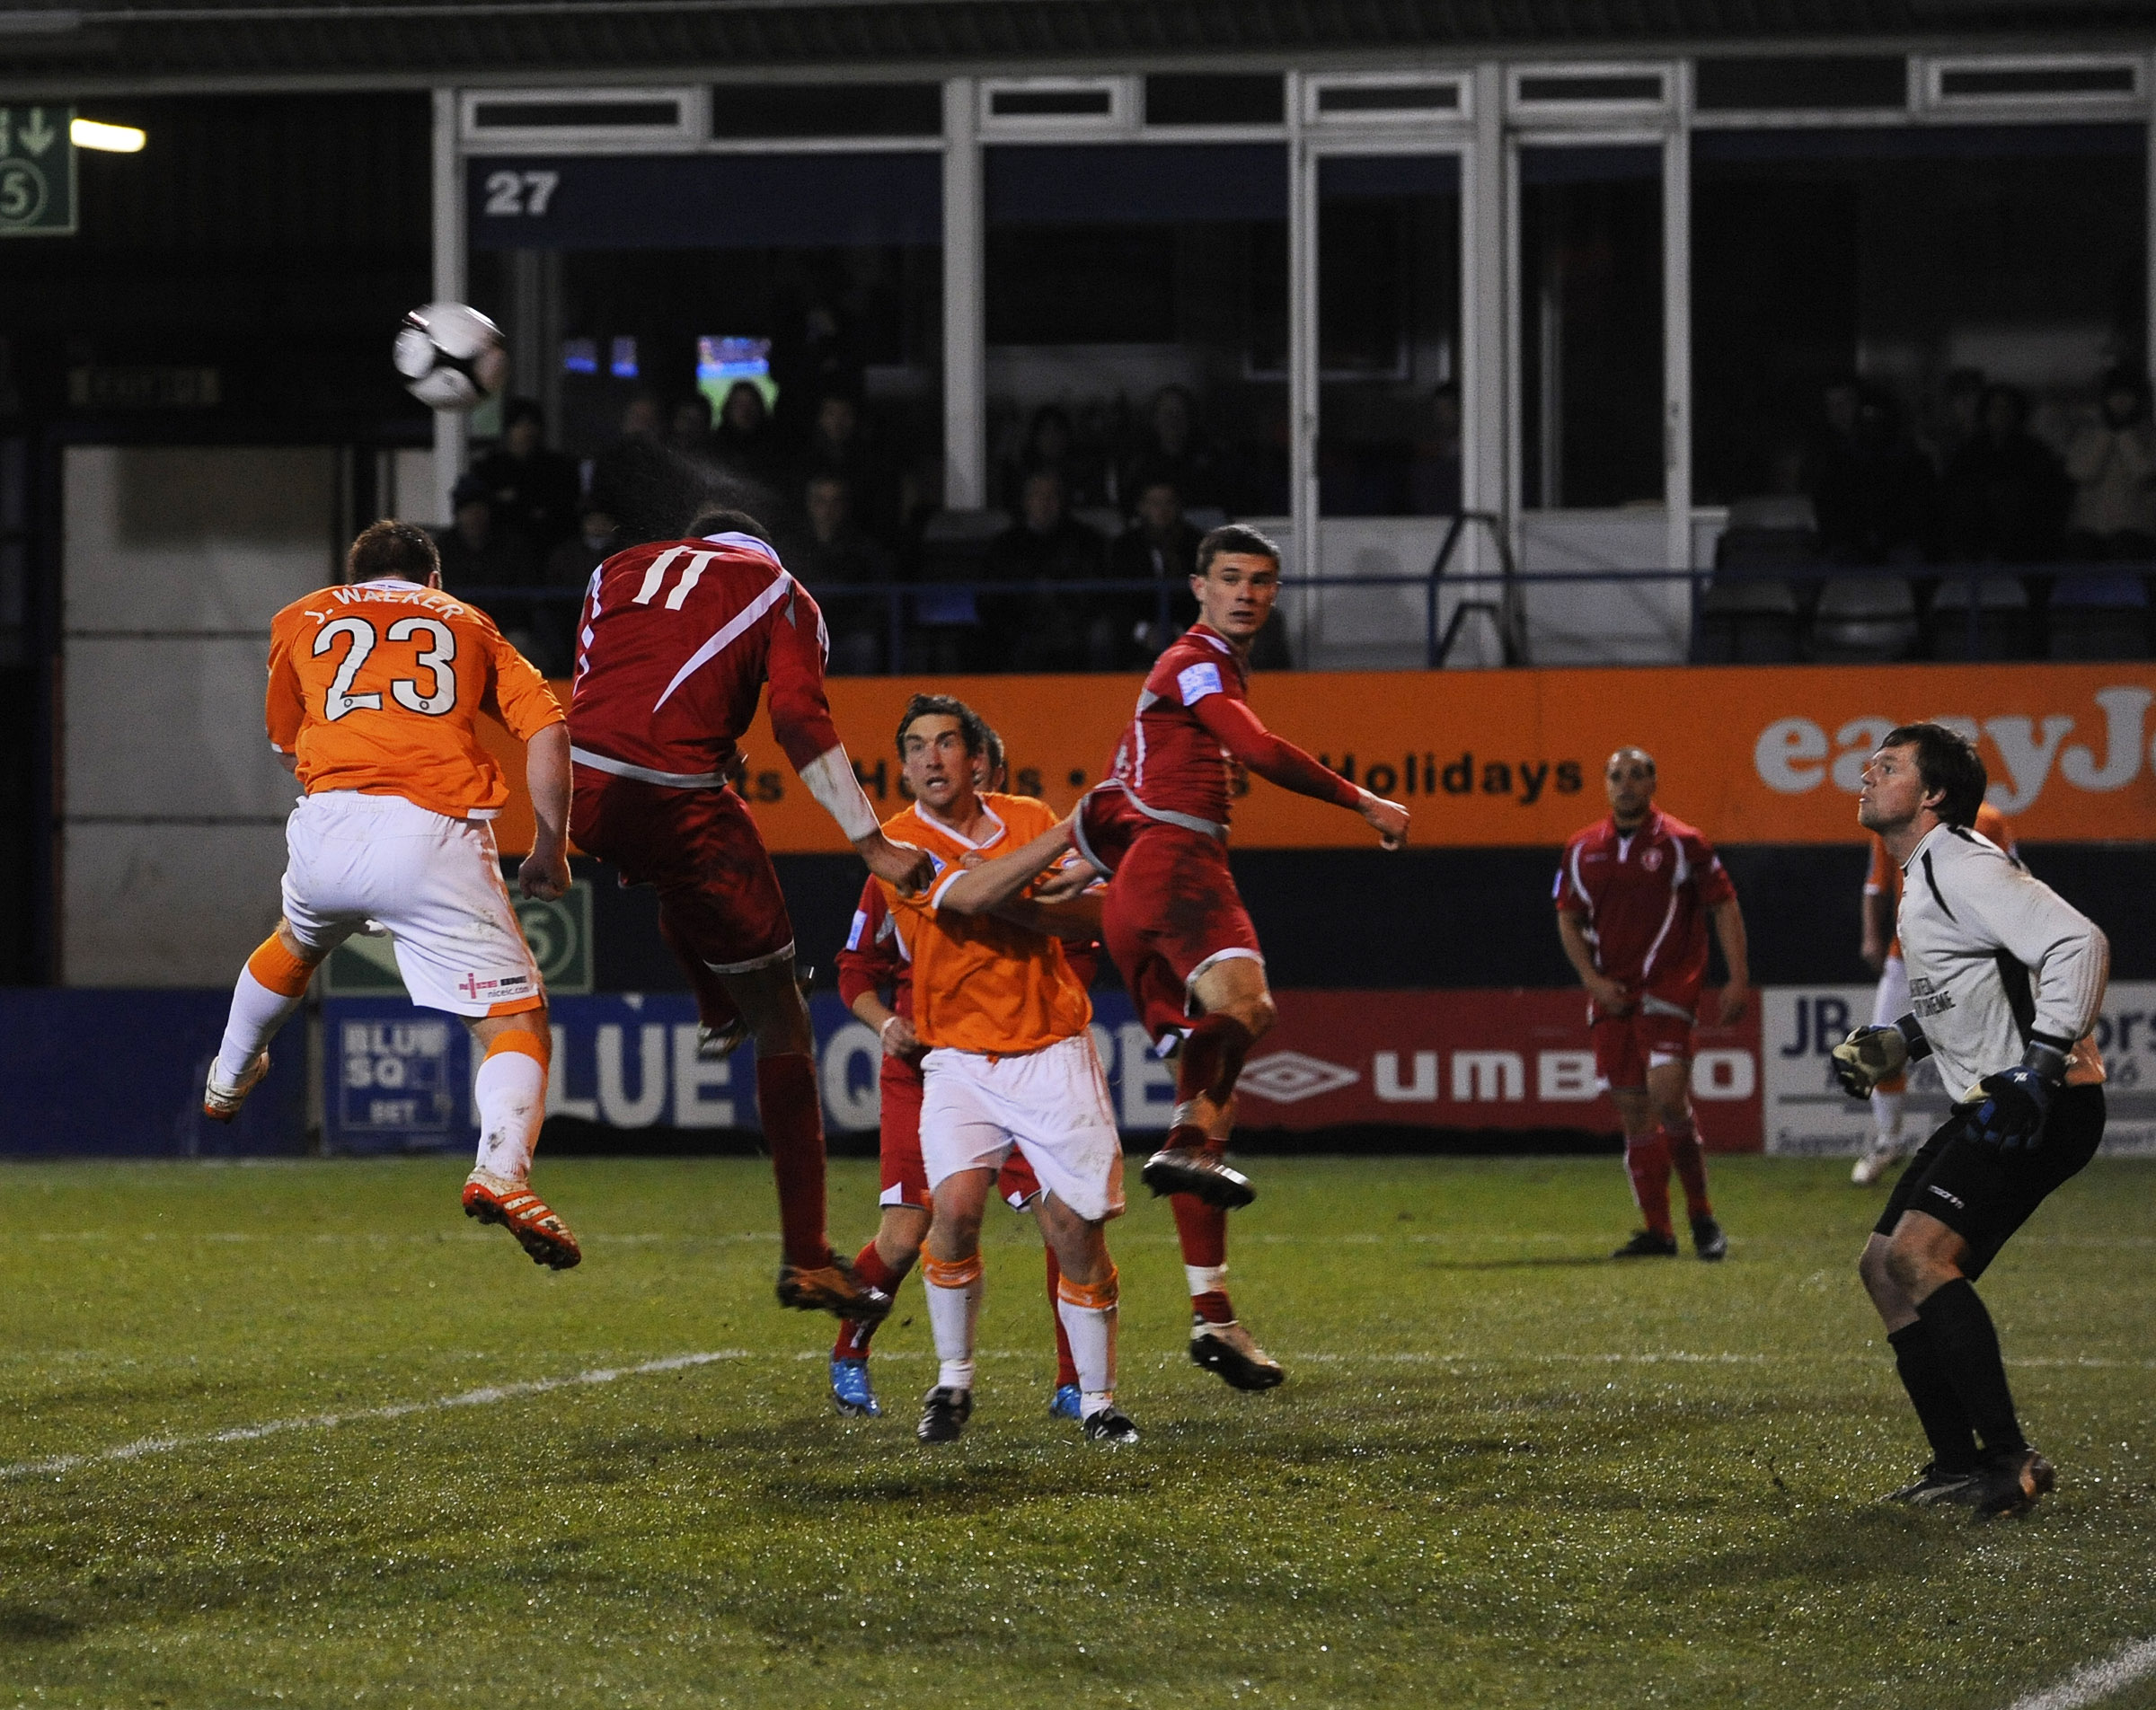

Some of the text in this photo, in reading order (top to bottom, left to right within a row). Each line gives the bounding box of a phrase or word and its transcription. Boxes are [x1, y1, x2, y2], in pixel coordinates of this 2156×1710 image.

[0, 171, 28, 215] 5
[485, 169, 559, 216] 27
[331, 588, 465, 620] WALKER
[631, 544, 726, 612] 11
[312, 616, 458, 722] 23
[520, 909, 553, 965] 5
[470, 1022, 736, 1129] LUE
[1372, 1048, 1757, 1103] UMBO
